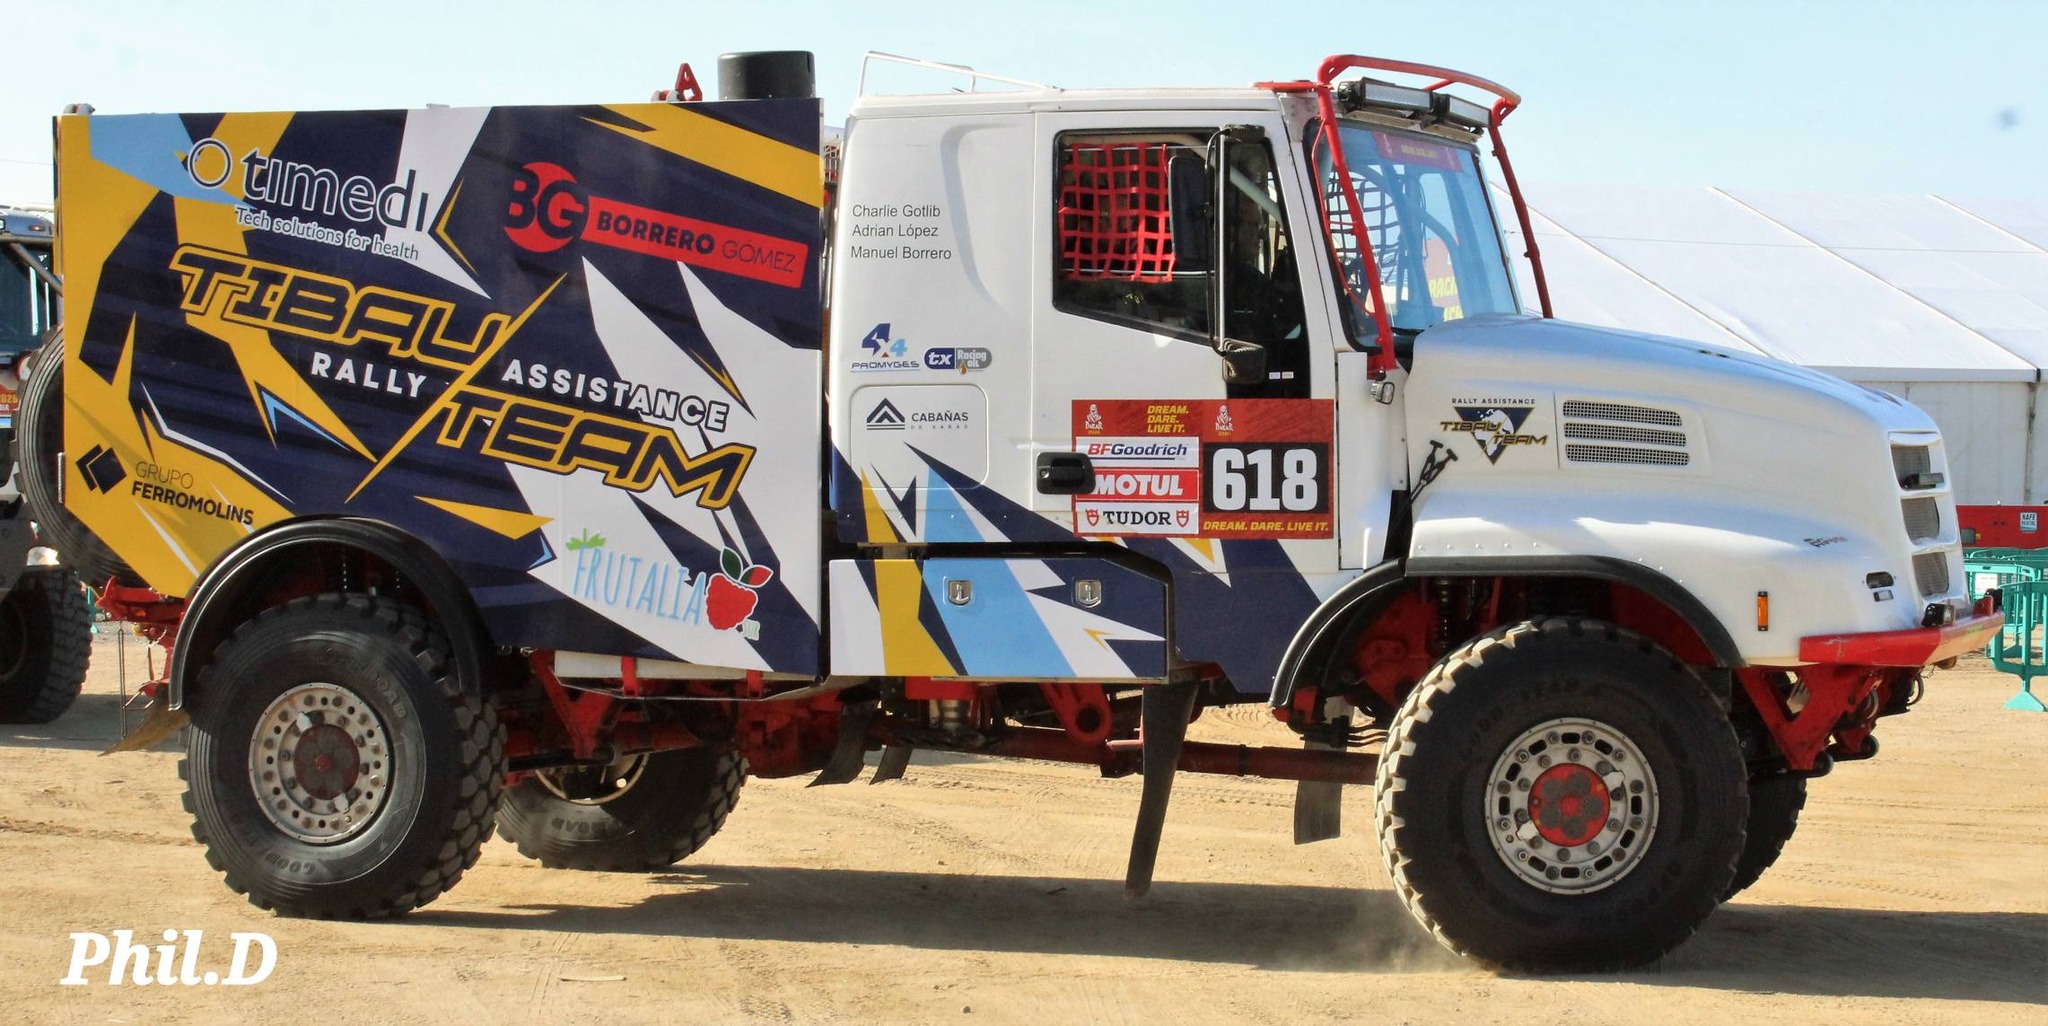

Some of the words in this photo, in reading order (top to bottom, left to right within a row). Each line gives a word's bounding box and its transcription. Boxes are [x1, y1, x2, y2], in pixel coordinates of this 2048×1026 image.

[503, 168, 590, 241] BG
[852, 204, 898, 217] Charlie
[902, 204, 941, 217] Gotlib
[235, 205, 273, 228] Tech
[273, 212, 342, 247] solutions
[345, 229, 372, 252] for
[373, 234, 419, 261] health
[852, 224, 894, 237] Adrian
[898, 223, 939, 239] López
[595, 210, 715, 255] BORRERO
[722, 238, 797, 273] GÓMEZ
[851, 246, 898, 259] Manuel
[902, 246, 952, 260] Borrero
[957, 349, 987, 362] Racing
[851, 360, 920, 370] PROMYGES
[310, 352, 427, 398] RALLY
[502, 359, 730, 433] ASSISTANCE
[911, 410, 969, 422] CABAÑAS
[1147, 405, 1190, 414] DREAM.
[1147, 415, 1180, 424] DARE.
[1147, 424, 1172, 433] LIVE
[1172, 424, 1186, 433] IT.
[1493, 434, 1548, 445] TEAM
[436, 388, 757, 511] TEAM
[1087, 443, 1188, 457] BFGoodrich
[135, 461, 194, 489] GRUPO
[1212, 447, 1318, 511] 618
[1093, 474, 1184, 496] MOTUL
[131, 480, 254, 525] FERROMOLINS
[1103, 511, 1171, 525] TUDOR
[1203, 521, 1248, 531] DREAM.
[1250, 522, 1285, 531] DARE.
[1287, 522, 1312, 531] LIVE
[1315, 522, 1329, 532] IT.
[572, 546, 707, 626] FRUTALIA
